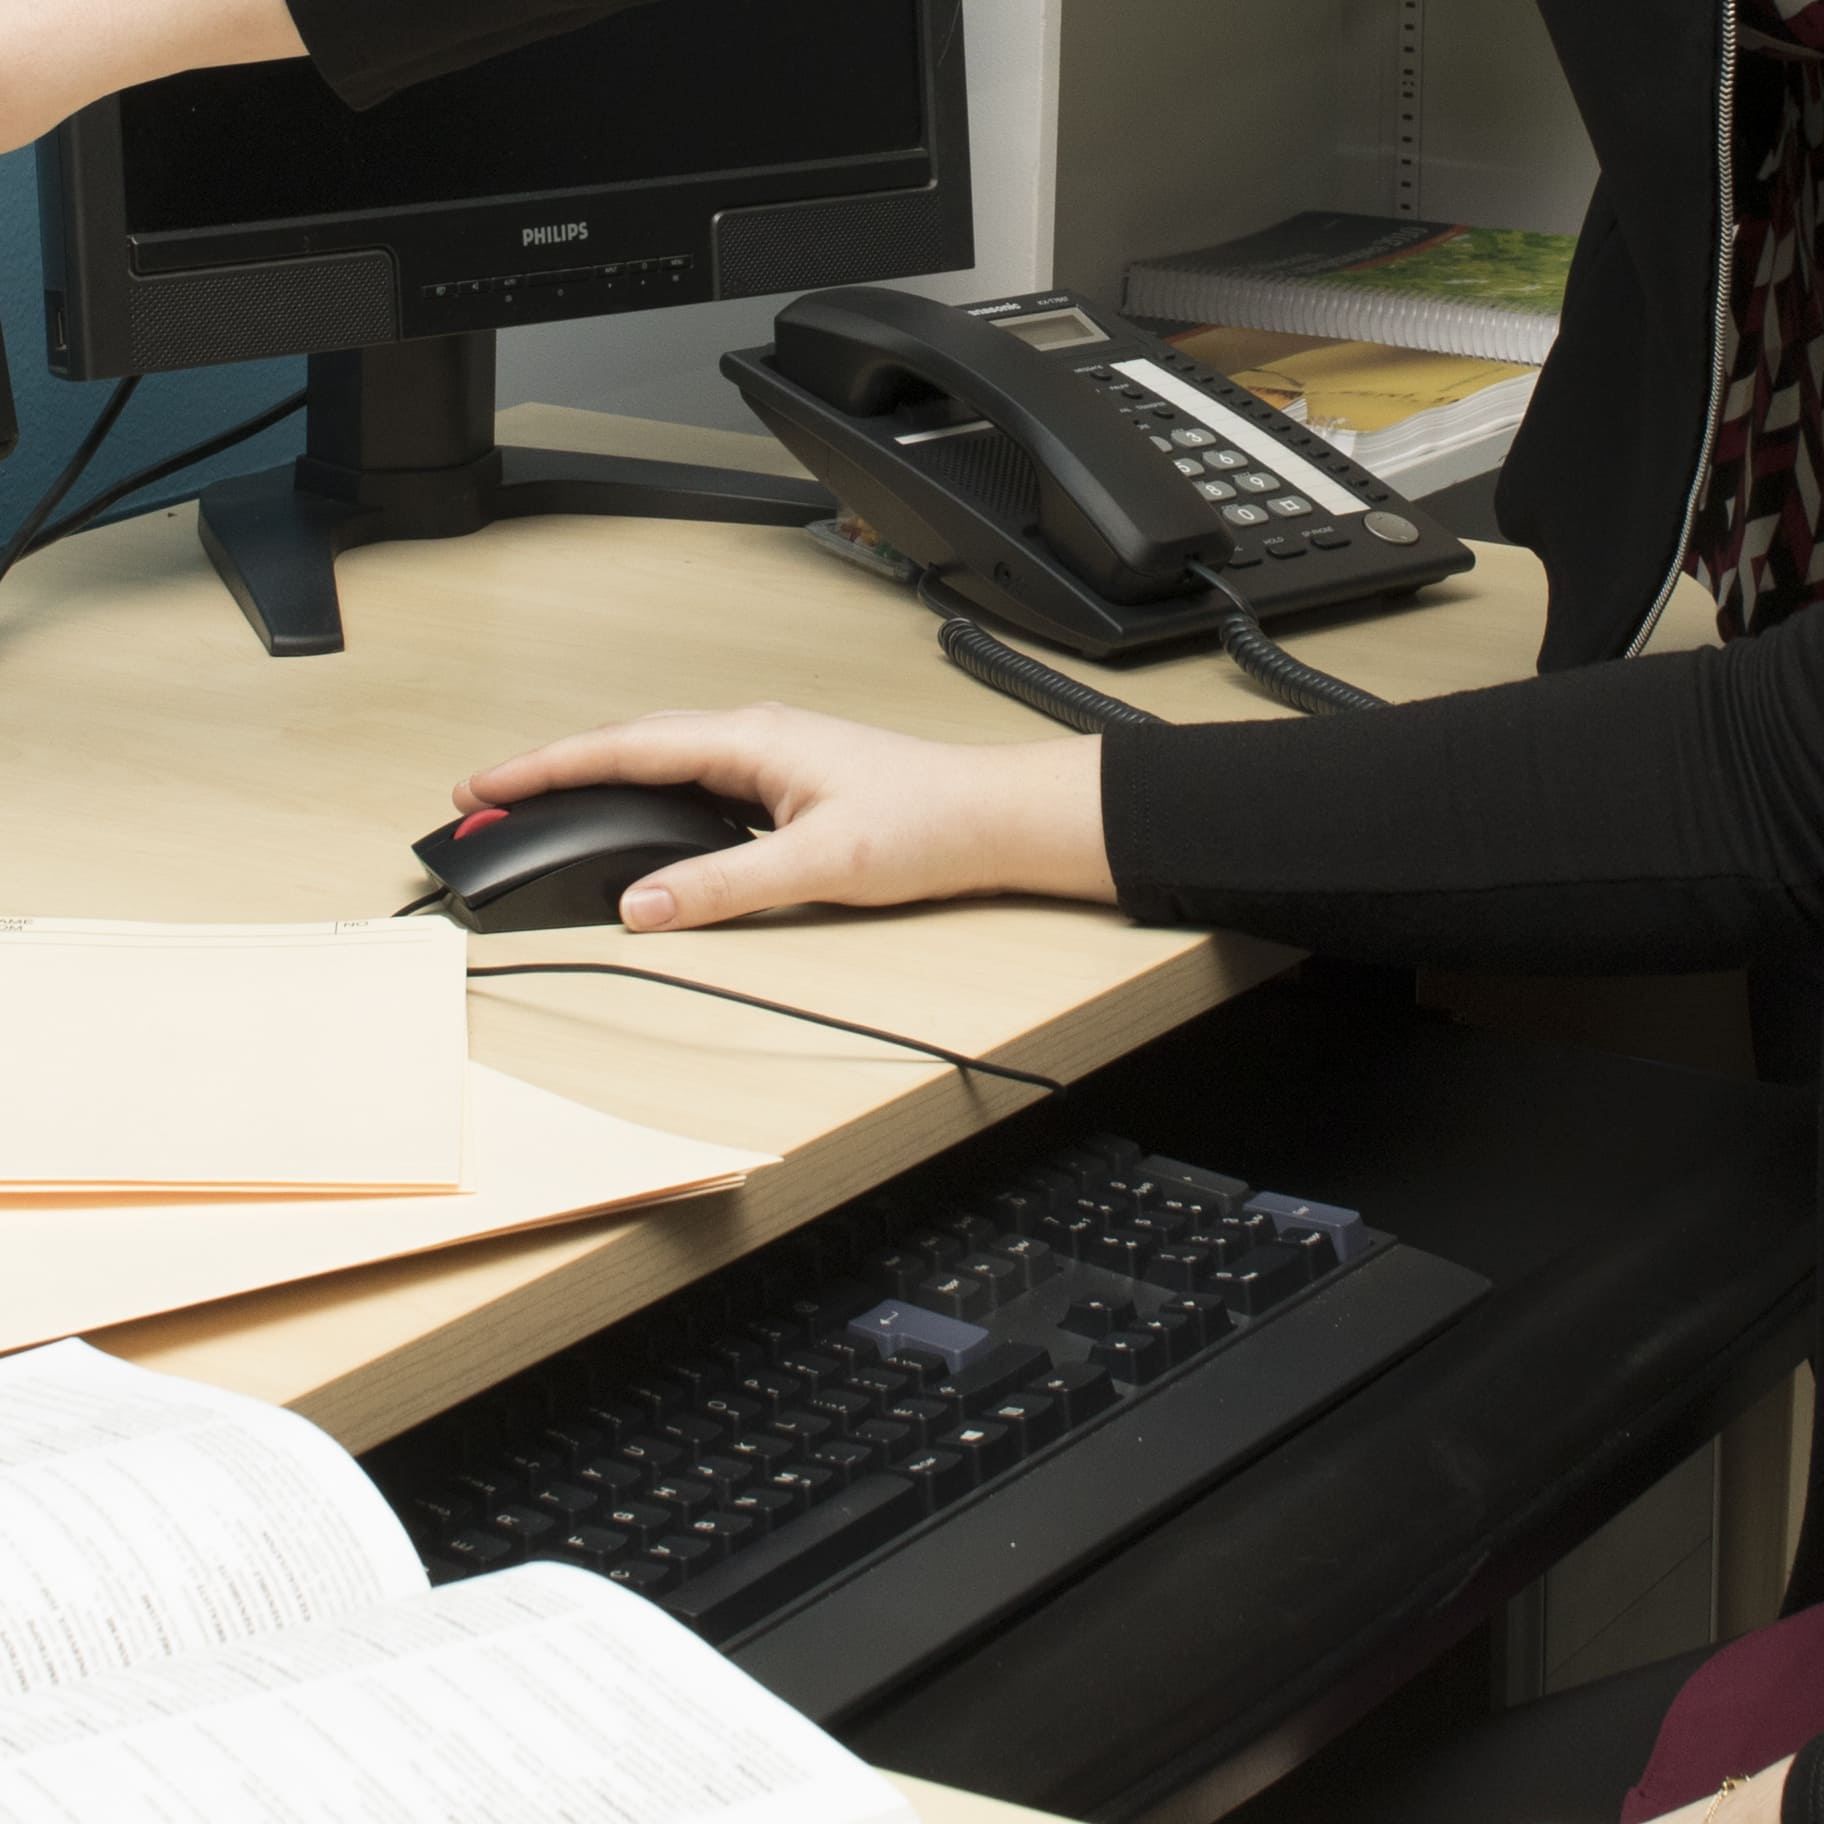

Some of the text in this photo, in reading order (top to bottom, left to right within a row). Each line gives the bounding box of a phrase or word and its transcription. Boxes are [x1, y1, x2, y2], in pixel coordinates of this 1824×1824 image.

[521, 221, 589, 247] PHILIPS
[1185, 431, 1203, 443] 3
[1218, 453, 1235, 465] 6
[1205, 476, 1265, 496] 8 9
[1237, 508, 1256, 521] 0
